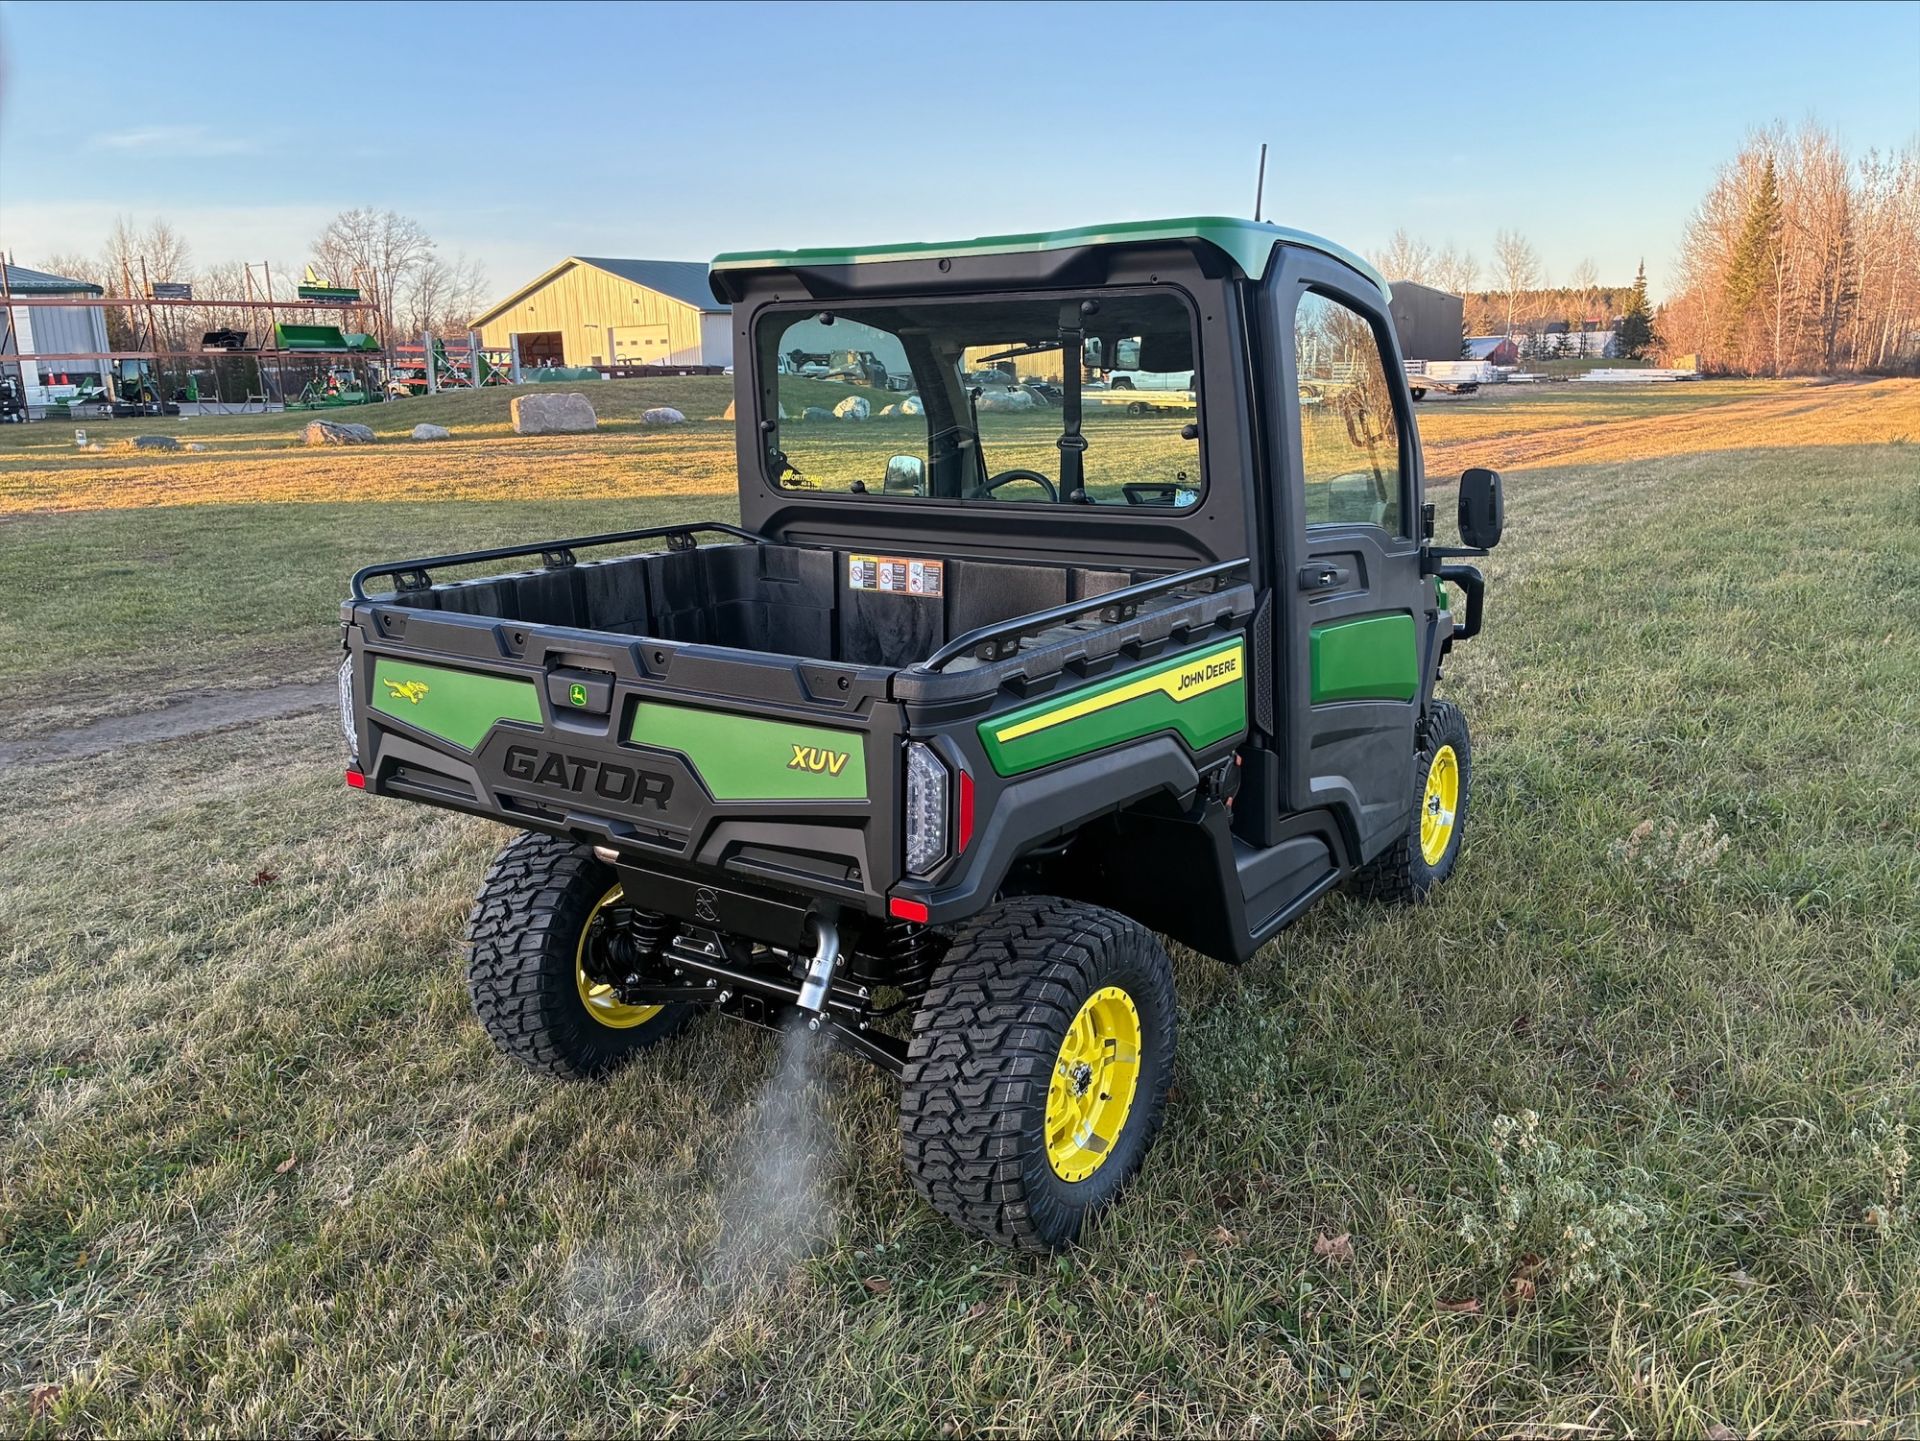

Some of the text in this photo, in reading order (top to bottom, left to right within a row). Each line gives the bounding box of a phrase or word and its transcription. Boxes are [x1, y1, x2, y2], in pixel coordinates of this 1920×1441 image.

[1178, 658, 1236, 691] JOHN DEERE
[503, 744, 674, 810] GATOR
[786, 743, 850, 777] XUV
